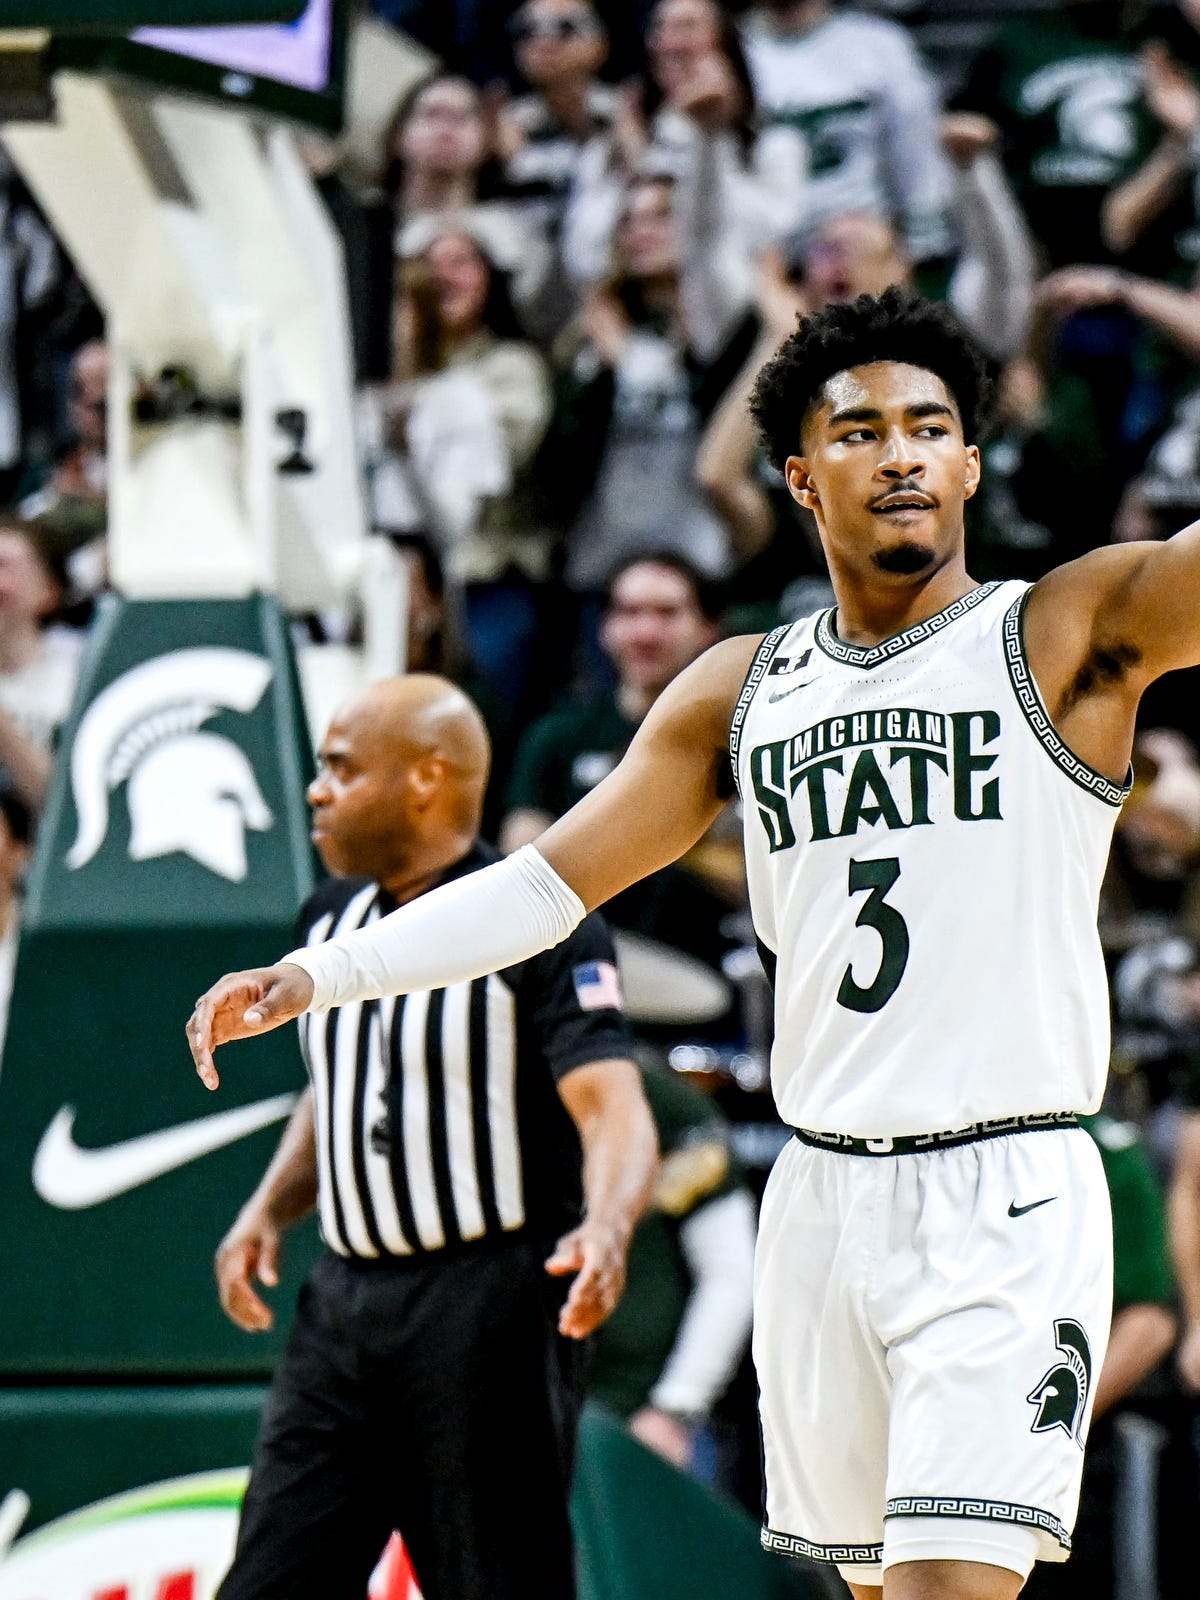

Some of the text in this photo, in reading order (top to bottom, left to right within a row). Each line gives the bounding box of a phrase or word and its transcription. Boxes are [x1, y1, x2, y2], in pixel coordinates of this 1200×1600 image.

[750, 710, 1004, 853] STATE
[793, 710, 942, 765] MICHIGAN
[837, 856, 910, 1014] 3
